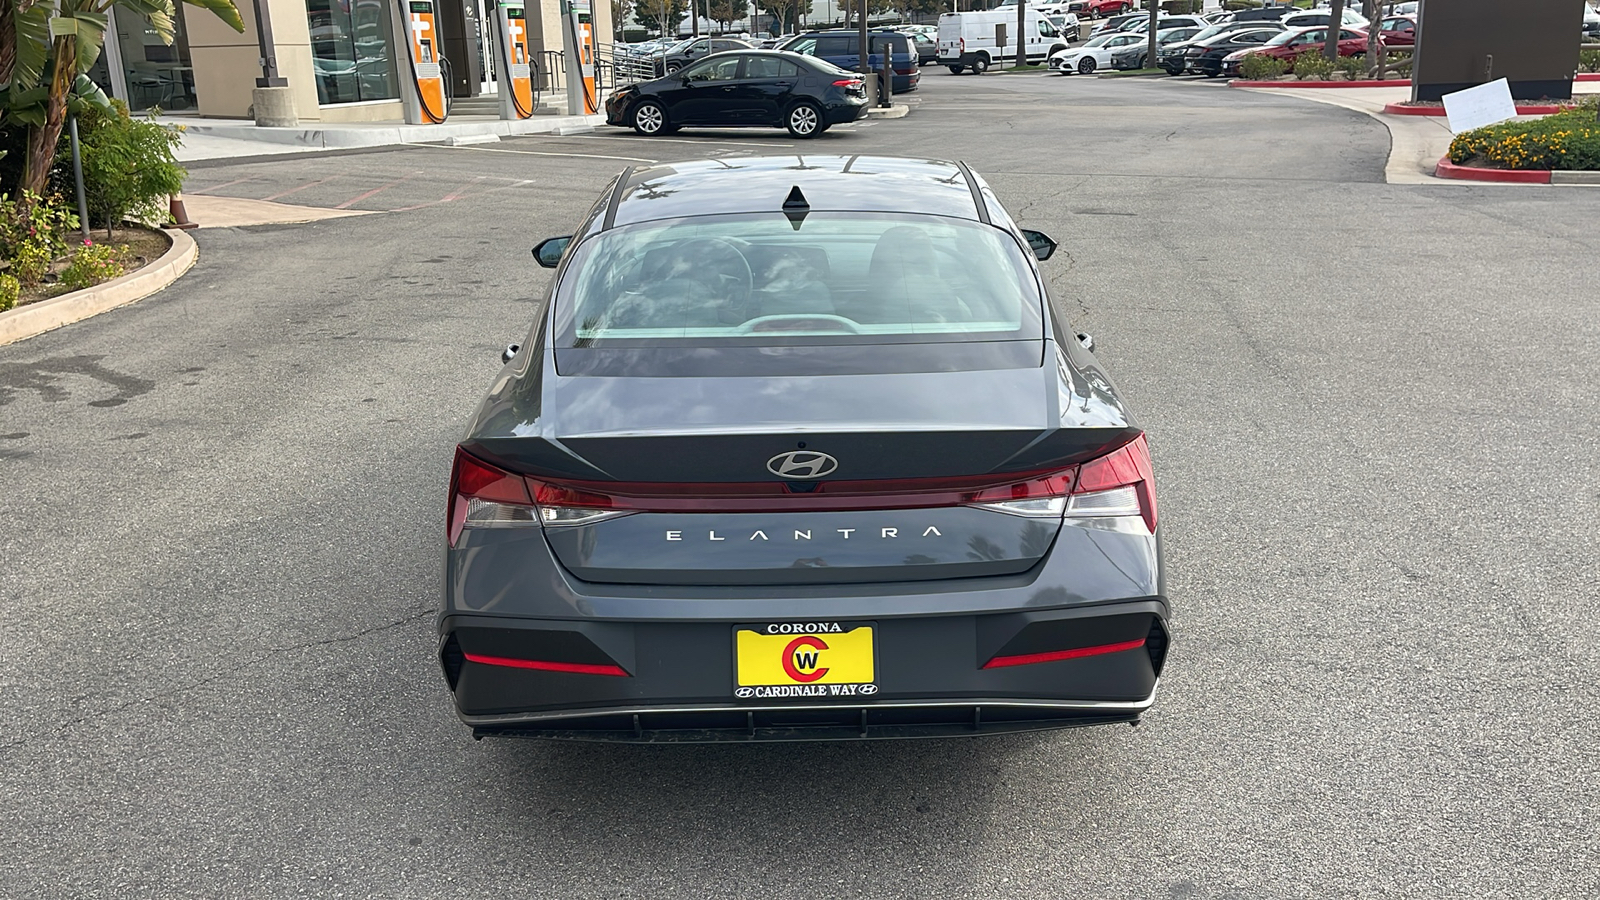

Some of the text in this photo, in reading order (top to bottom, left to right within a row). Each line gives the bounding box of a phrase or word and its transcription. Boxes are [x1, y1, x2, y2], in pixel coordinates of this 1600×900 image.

[666, 526, 942, 541] ELANTRA
[767, 622, 843, 634] CORONA
[755, 684, 858, 698] CARDINALE WAY
